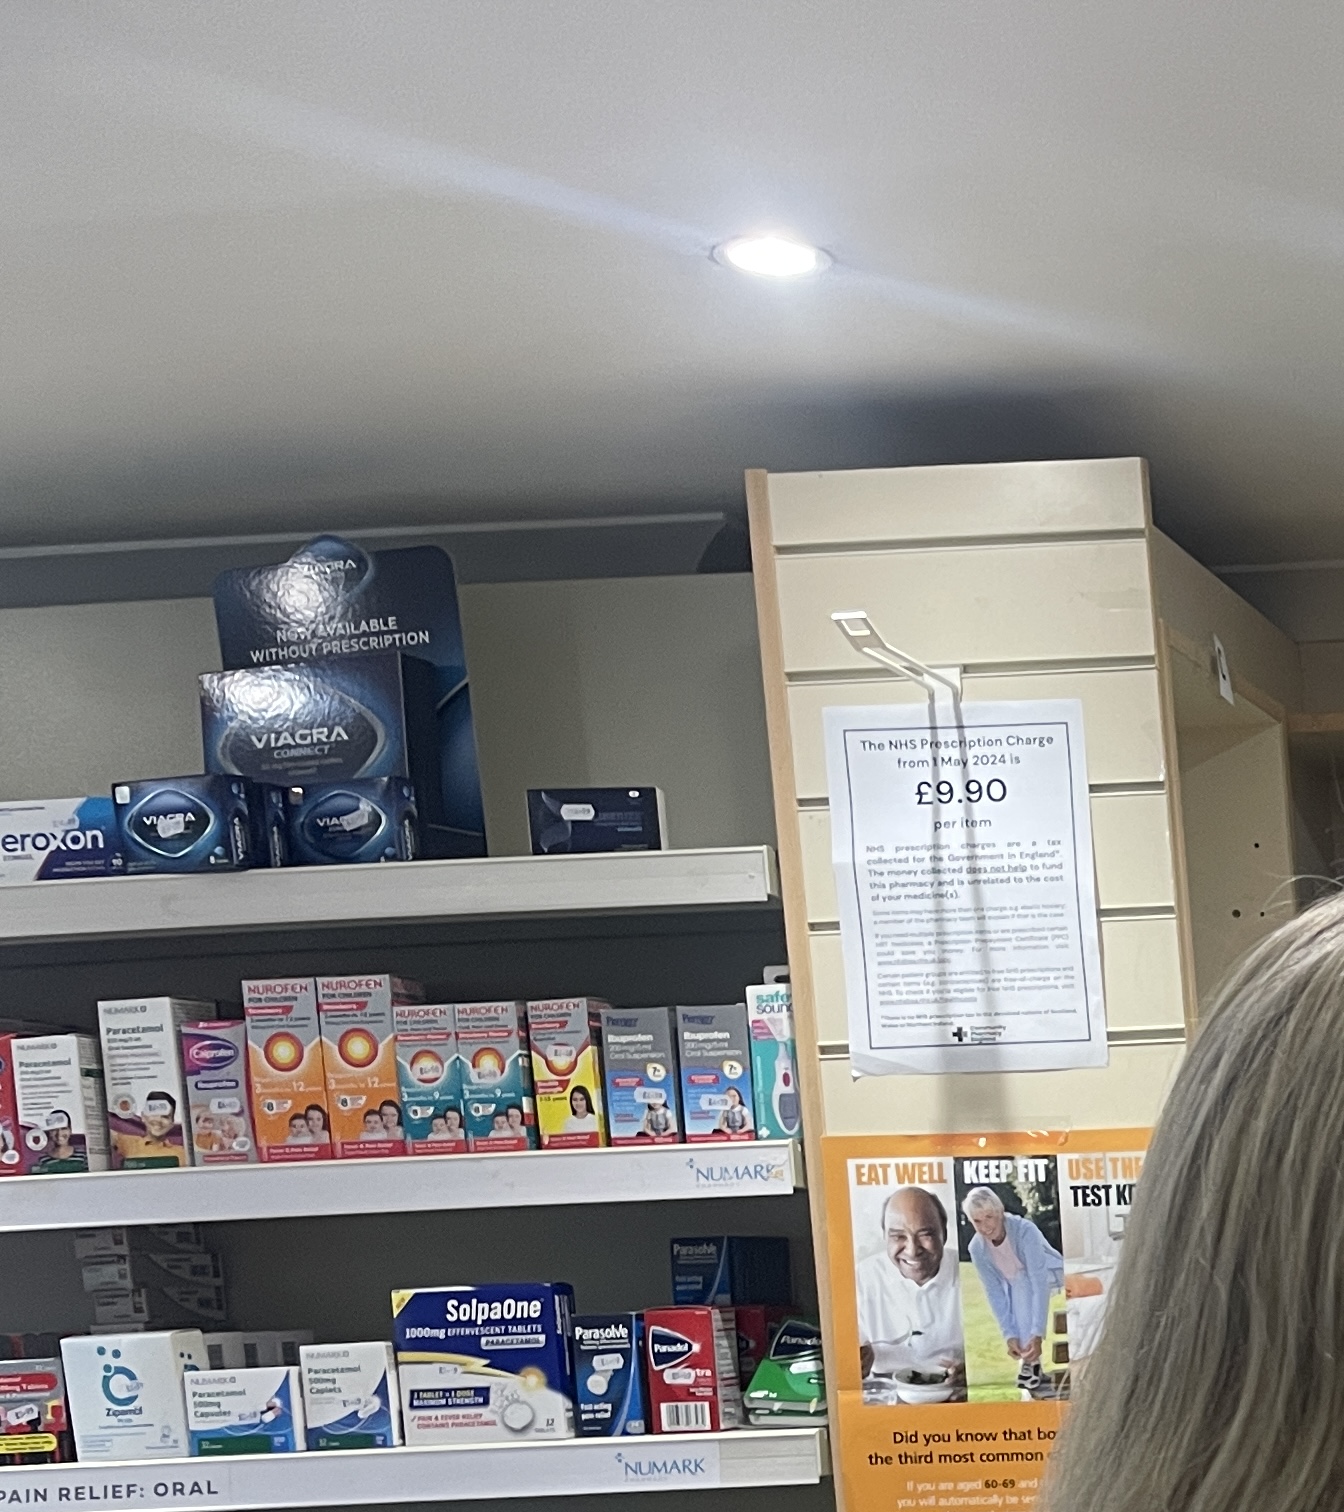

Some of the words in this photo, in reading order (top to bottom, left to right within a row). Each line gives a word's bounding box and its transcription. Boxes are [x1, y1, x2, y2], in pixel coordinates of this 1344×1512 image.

[276, 627, 312, 643] NOW
[317, 616, 398, 637] AVAILABLE
[250, 643, 318, 663] WITHOUT
[322, 631, 430, 655] PRESCRIPTION
[250, 725, 350, 749] VIAGRA
[861, 740, 885, 751] The
[889, 738, 917, 750] NHS
[921, 736, 1003, 750] Prescription
[1006, 735, 1054, 748] Charge
[273, 744, 331, 759] CONNECT
[897, 757, 929, 769] from
[941, 756, 969, 769] May
[972, 754, 1007, 766] 2024
[1010, 753, 1021, 765] is
[915, 778, 1008, 806] £9.90
[934, 820, 957, 832] per
[960, 817, 992, 828] item
[1, 829, 105, 852] eroxon
[247, 983, 309, 995] NUROFEN
[321, 979, 383, 991] NUROFEN
[756, 990, 792, 1003] safe
[395, 1007, 447, 1019] NUROFEN
[457, 1005, 509, 1018] NUROFEN
[530, 1002, 580, 1013] NUROFEN
[106, 1024, 164, 1036] Paracetamol
[683, 1031, 730, 1041] Ibuprofen
[608, 1033, 654, 1043] Ibuprofen
[696, 1163, 776, 1182] NUMARK
[855, 1163, 891, 1186] EAT
[894, 1162, 948, 1185] WELL
[963, 1159, 1012, 1184] KEEP
[1015, 1158, 1049, 1183] FIT
[1067, 1157, 1105, 1181] USE
[1069, 1184, 1112, 1207] TEST
[1115, 1184, 1135, 1206] KI
[446, 1297, 542, 1325] SolpaOne
[405, 1327, 446, 1339] 1000mg
[447, 1325, 506, 1337] EFFERVESCENT
[507, 1324, 542, 1334] TABLETS
[575, 1323, 629, 1340] Parasolve
[484, 1336, 541, 1347] PARACETAMOL
[654, 1342, 689, 1353] Panadol
[307, 1365, 361, 1375] Paracetamol
[192, 1388, 246, 1399] Paracetamol
[892, 1430, 918, 1444] Did
[923, 1434, 951, 1446] you
[955, 1429, 998, 1443] know
[1002, 1428, 1033, 1441] that
[868, 1452, 893, 1465] the
[898, 1451, 933, 1465] third
[938, 1451, 975, 1464] most
[979, 1451, 1044, 1463] common
[624, 1458, 705, 1476] NUMARK
[58, 1483, 145, 1502] RELIEF:
[153, 1480, 219, 1498] ORAL
[984, 1478, 1016, 1489] 60-69
